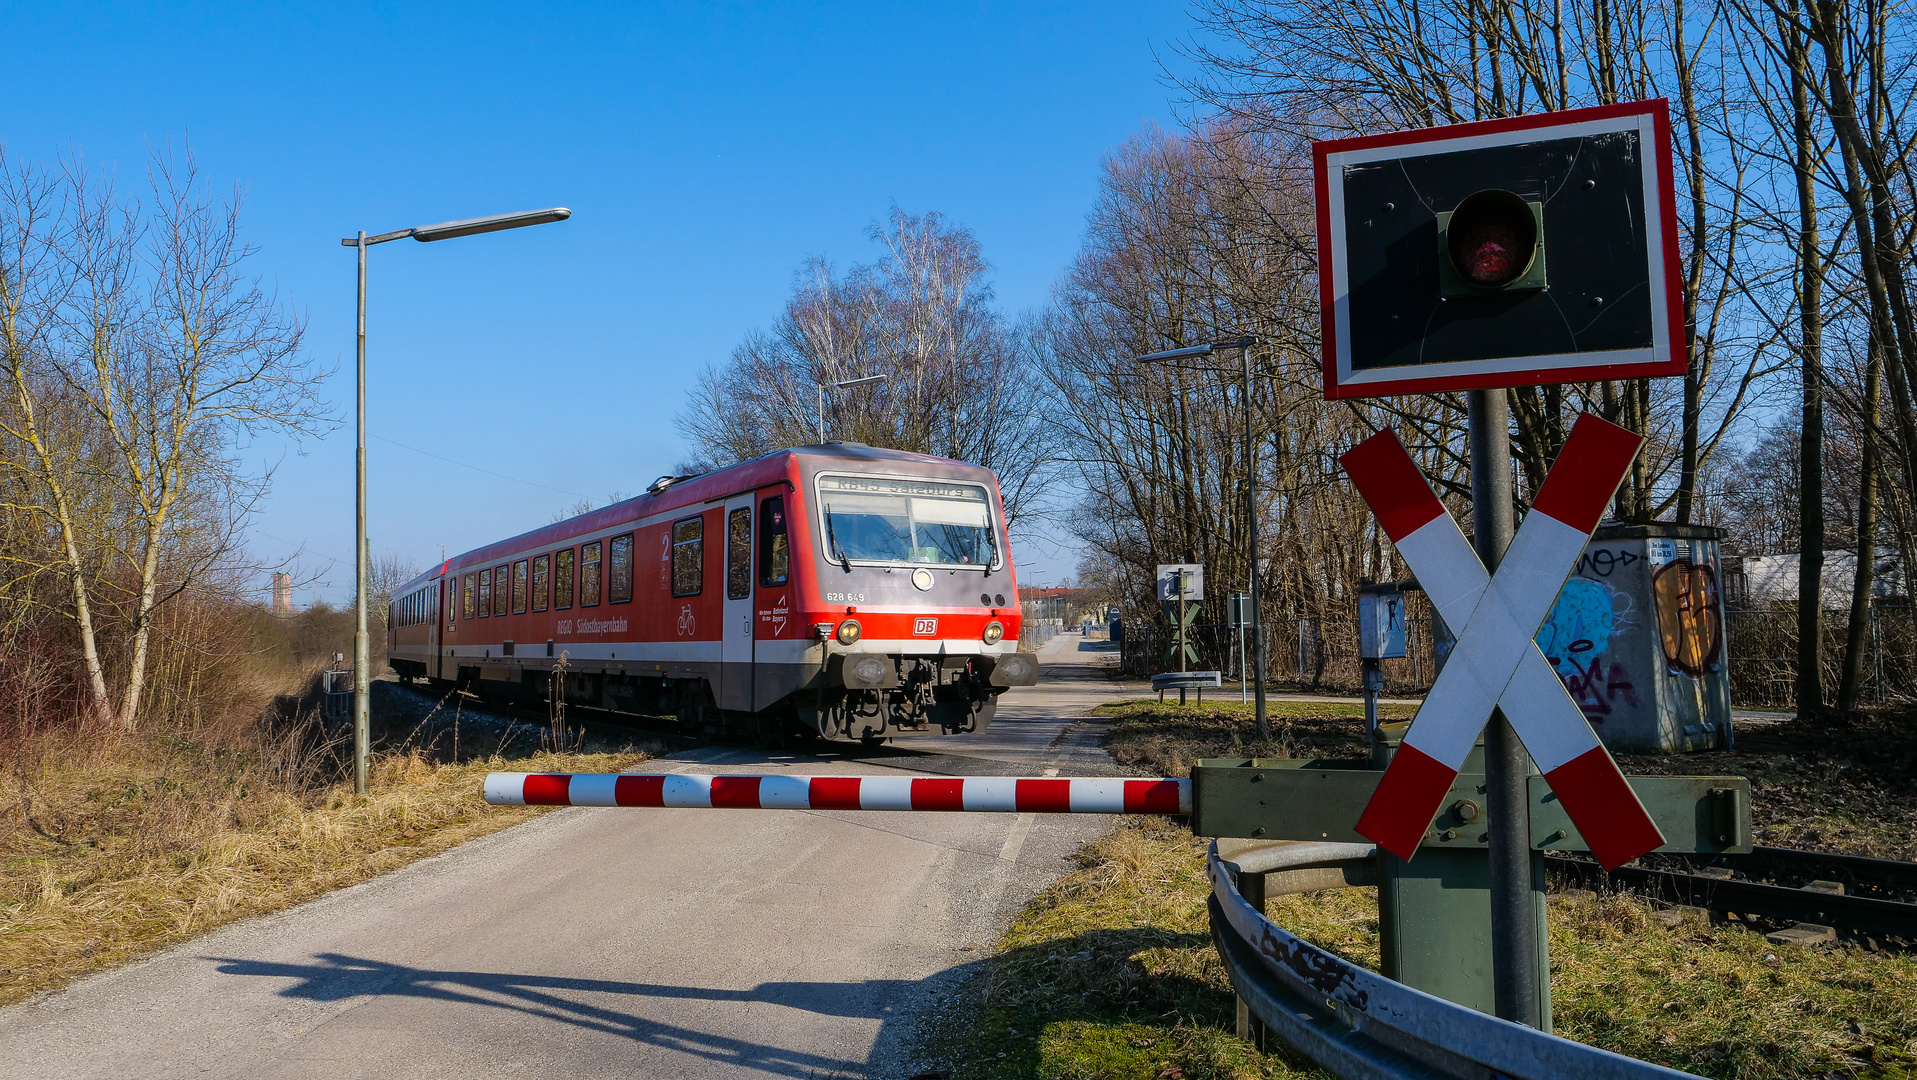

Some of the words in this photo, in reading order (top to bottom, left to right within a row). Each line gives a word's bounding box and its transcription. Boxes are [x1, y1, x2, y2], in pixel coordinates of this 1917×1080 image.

[839, 480, 879, 491] RB45
[889, 482, 964, 497] Salzburg
[662, 535, 669, 561] 2
[827, 592, 844, 601] 628
[847, 593, 865, 602] 649
[557, 619, 572, 635] REGIO
[577, 616, 628, 637] Südostbayernbahn
[916, 620, 935, 633] DB
